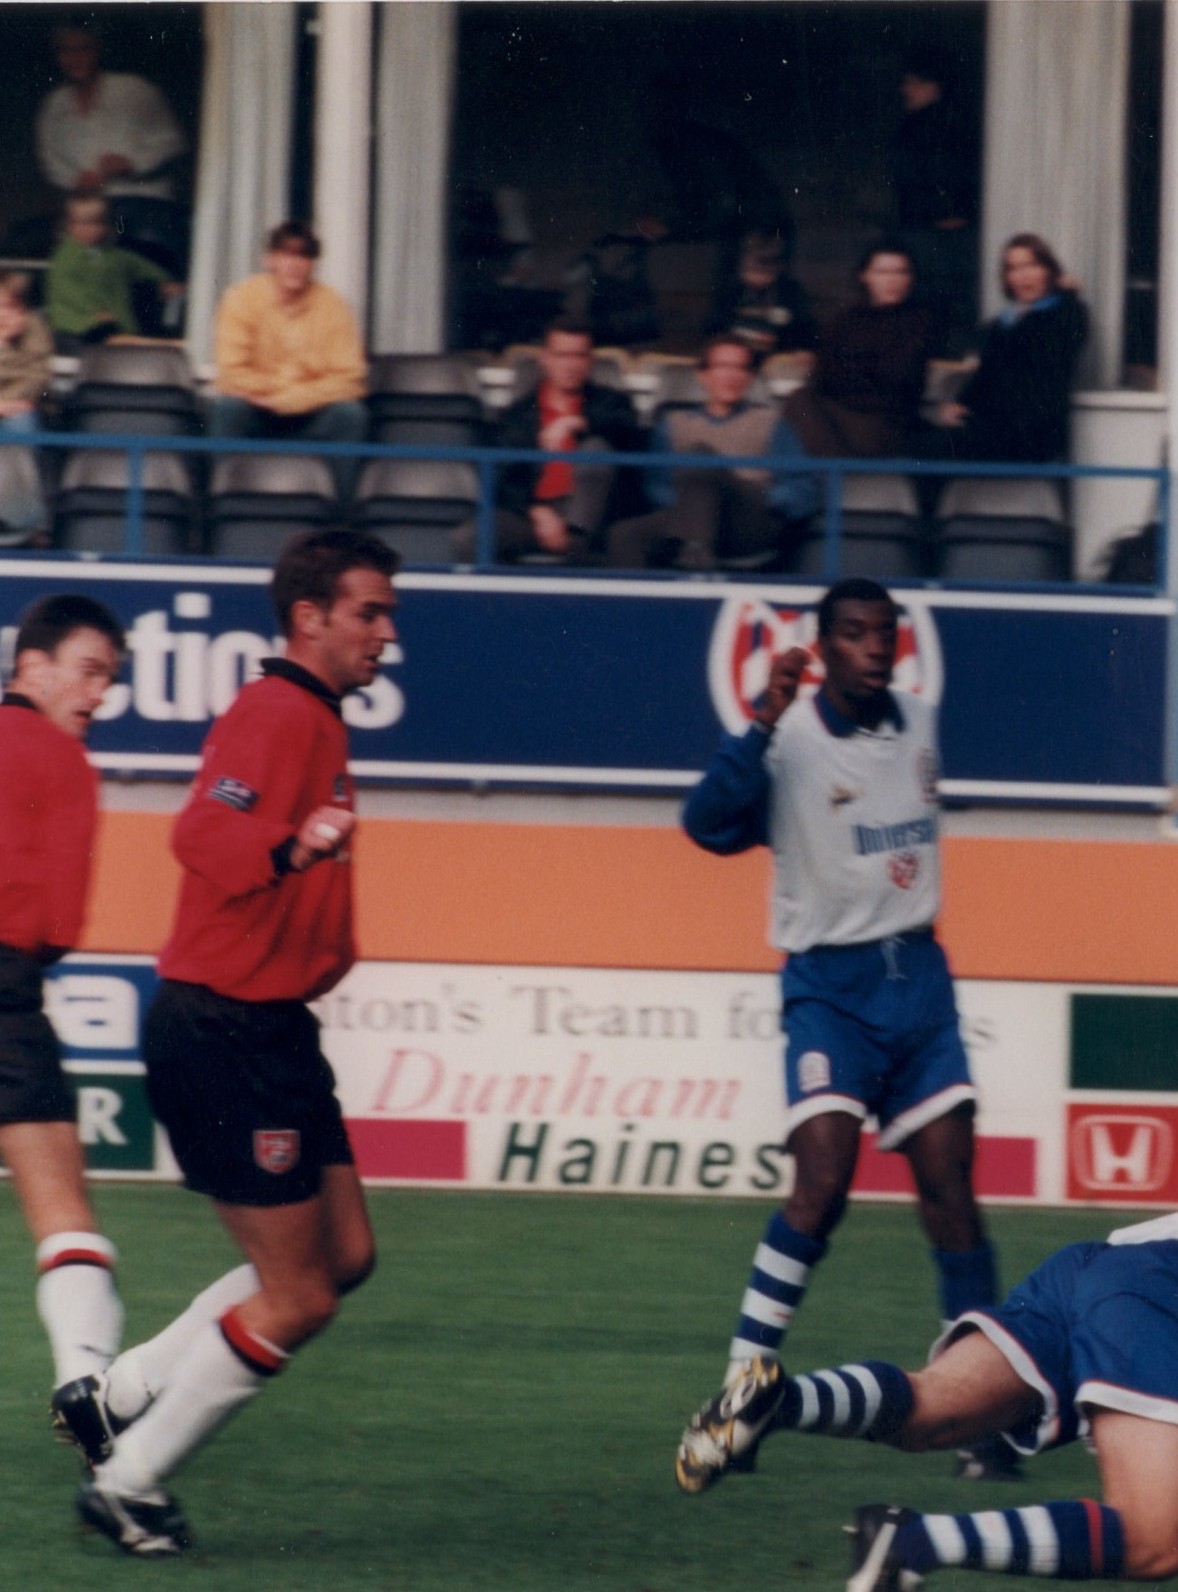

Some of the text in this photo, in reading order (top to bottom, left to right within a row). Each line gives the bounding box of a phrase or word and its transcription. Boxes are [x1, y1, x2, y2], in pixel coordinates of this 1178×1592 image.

[510, 985, 698, 1040] Team
[370, 1047, 743, 1119] Dunham
[496, 1121, 790, 1190] Haines
